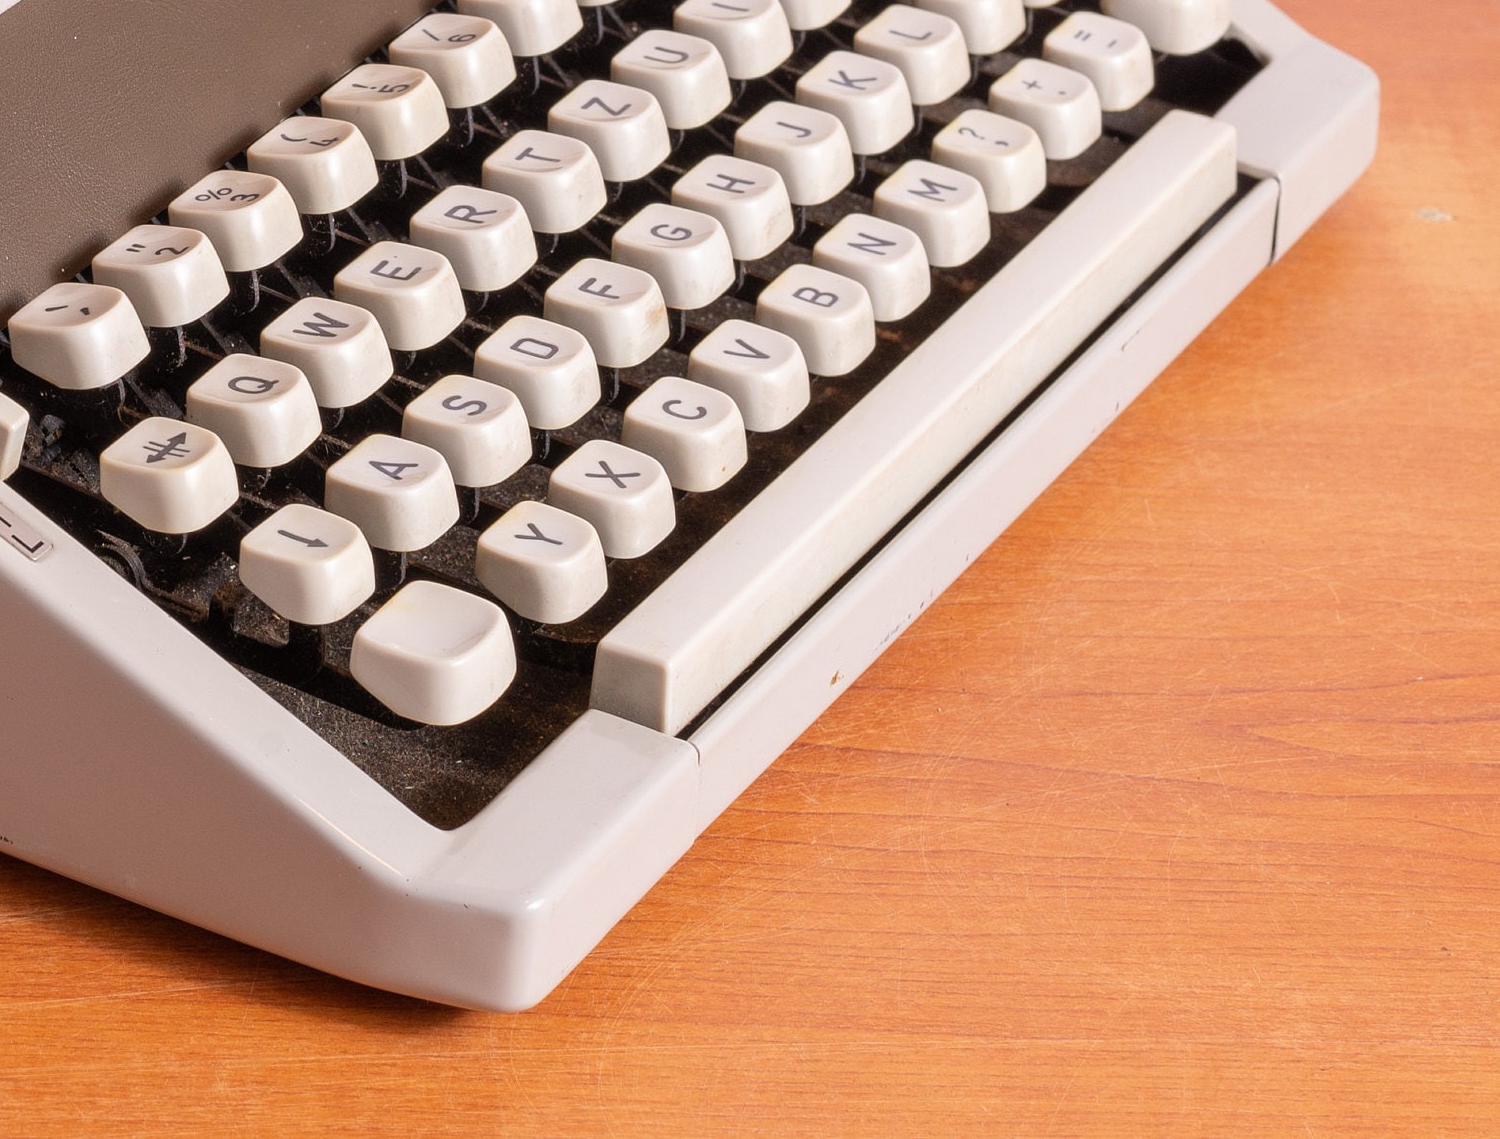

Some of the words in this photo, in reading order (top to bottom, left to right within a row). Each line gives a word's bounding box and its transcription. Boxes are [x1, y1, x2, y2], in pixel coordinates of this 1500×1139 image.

[712, 3, 749, 12] I
[448, 34, 477, 42] 6
[889, 30, 932, 41] L
[644, 46, 689, 64] U
[378, 84, 410, 92] 5
[828, 70, 877, 90] K
[1023, 81, 1041, 89] +
[581, 97, 631, 116] Z
[777, 122, 811, 138] J
[958, 127, 984, 140] ?
[310, 137, 340, 146] 4
[515, 148, 560, 162] T
[706, 174, 755, 194] H
[908, 178, 958, 202] M
[194, 187, 232, 202] %
[229, 192, 260, 203] 3
[444, 205, 497, 224] R
[650, 224, 692, 241] G
[155, 246, 189, 255] 2
[848, 233, 896, 255] N
[370, 260, 422, 280] E
[578, 278, 620, 299] F
[792, 288, 838, 307] B
[292, 312, 349, 337] W
[510, 338, 558, 359] D
[724, 339, 770, 359] V
[228, 376, 279, 394] Q
[442, 396, 487, 416] S
[662, 400, 707, 420] C
[369, 458, 419, 480] A
[585, 461, 640, 488] X
[514, 523, 563, 545] Y
[12, 535, 44, 553] L
